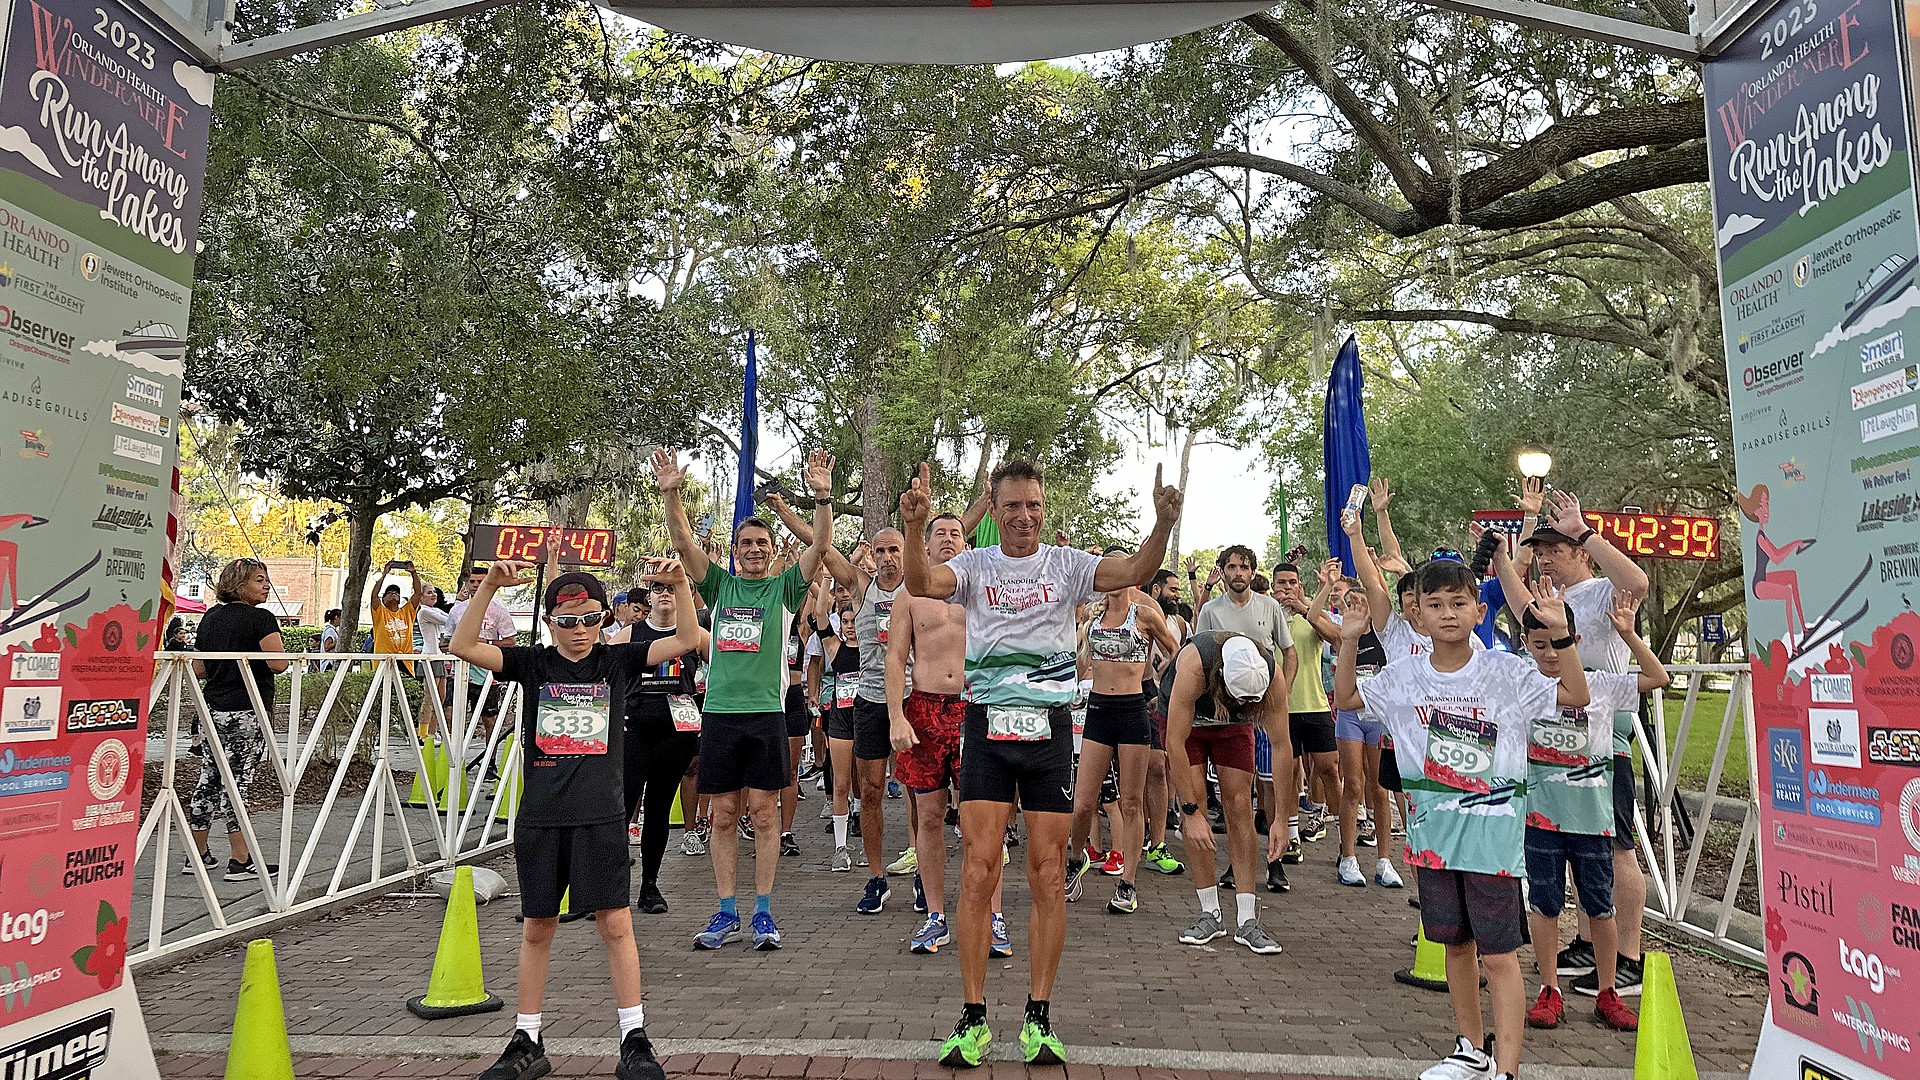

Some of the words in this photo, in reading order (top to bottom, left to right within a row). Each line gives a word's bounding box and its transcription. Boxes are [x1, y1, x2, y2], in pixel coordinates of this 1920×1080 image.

[93, 8, 156, 70] 2023
[1759, 0, 1818, 61] 2023
[71, 32, 127, 79] ORLANDO
[125, 69, 166, 107] HEALTH
[1748, 53, 1794, 99] ORLANDO
[1793, 21, 1836, 64] HEALTH
[29, 70, 105, 167] Run
[105, 122, 189, 210] Among
[1728, 132, 1792, 201] Run
[1789, 73, 1880, 166] Among
[1775, 167, 1803, 202] the
[1799, 122, 1892, 218] Lakes
[81, 150, 111, 191] the
[100, 168, 188, 254] Lakes
[0, 208, 70, 254] ORLANDO
[1811, 241, 1843, 264] Jewett
[1844, 209, 1902, 247] Orthopedic
[3, 231, 61, 270] HEALTH
[1812, 252, 1852, 280] Institute
[15, 277, 41, 295] FIRST
[42, 289, 85, 315] ACADEMY
[45, 281, 57, 291] THE
[100, 274, 139, 299] Institute
[101, 260, 134, 283] Jewett
[134, 274, 183, 305] Orthopedic
[1729, 269, 1783, 307] ORLANDO
[1736, 290, 1780, 321] HEALTH
[1771, 316, 1782, 326] THE
[0, 305, 75, 349] Observer
[1750, 331, 1769, 348] FIRST
[1771, 312, 1806, 335] ACADEMY
[1743, 351, 1804, 387] Observer
[127, 375, 164, 399] Smart
[45, 401, 88, 422] GRILLS
[1742, 429, 1790, 451] PARADISE
[1792, 416, 1831, 436] GRILLS
[98, 503, 147, 527] Lakeside
[1861, 492, 1912, 523] Lakeside
[113, 547, 143, 559] WINDERMERE
[496, 528, 609, 563] 0:2:40
[105, 558, 146, 580] BREWING
[726, 627, 752, 639] 500
[1100, 643, 1121, 654] 661
[30, 719, 55, 727] GARDEN
[552, 716, 593, 735] 333
[679, 711, 697, 721] 645
[1002, 716, 1036, 733] 148
[1542, 731, 1577, 749] 598
[1813, 741, 1834, 752] WINTER
[1834, 743, 1858, 754] GARDEN
[1437, 745, 1478, 770] 599
[1774, 738, 1799, 774] SKR
[23, 777, 63, 789] SERVICES
[1776, 790, 1801, 803] REALTY
[1808, 769, 1880, 800] Windermere
[1815, 802, 1836, 815] POOL
[1838, 806, 1875, 821] SERVICES
[65, 844, 119, 869] FAMILY
[62, 860, 125, 889] CHURCH
[1777, 869, 1836, 918] Pistil
[0, 909, 49, 945] tag
[1838, 937, 1885, 994] tag
[1831, 1008, 1911, 1053] WATERGRAPHICS
